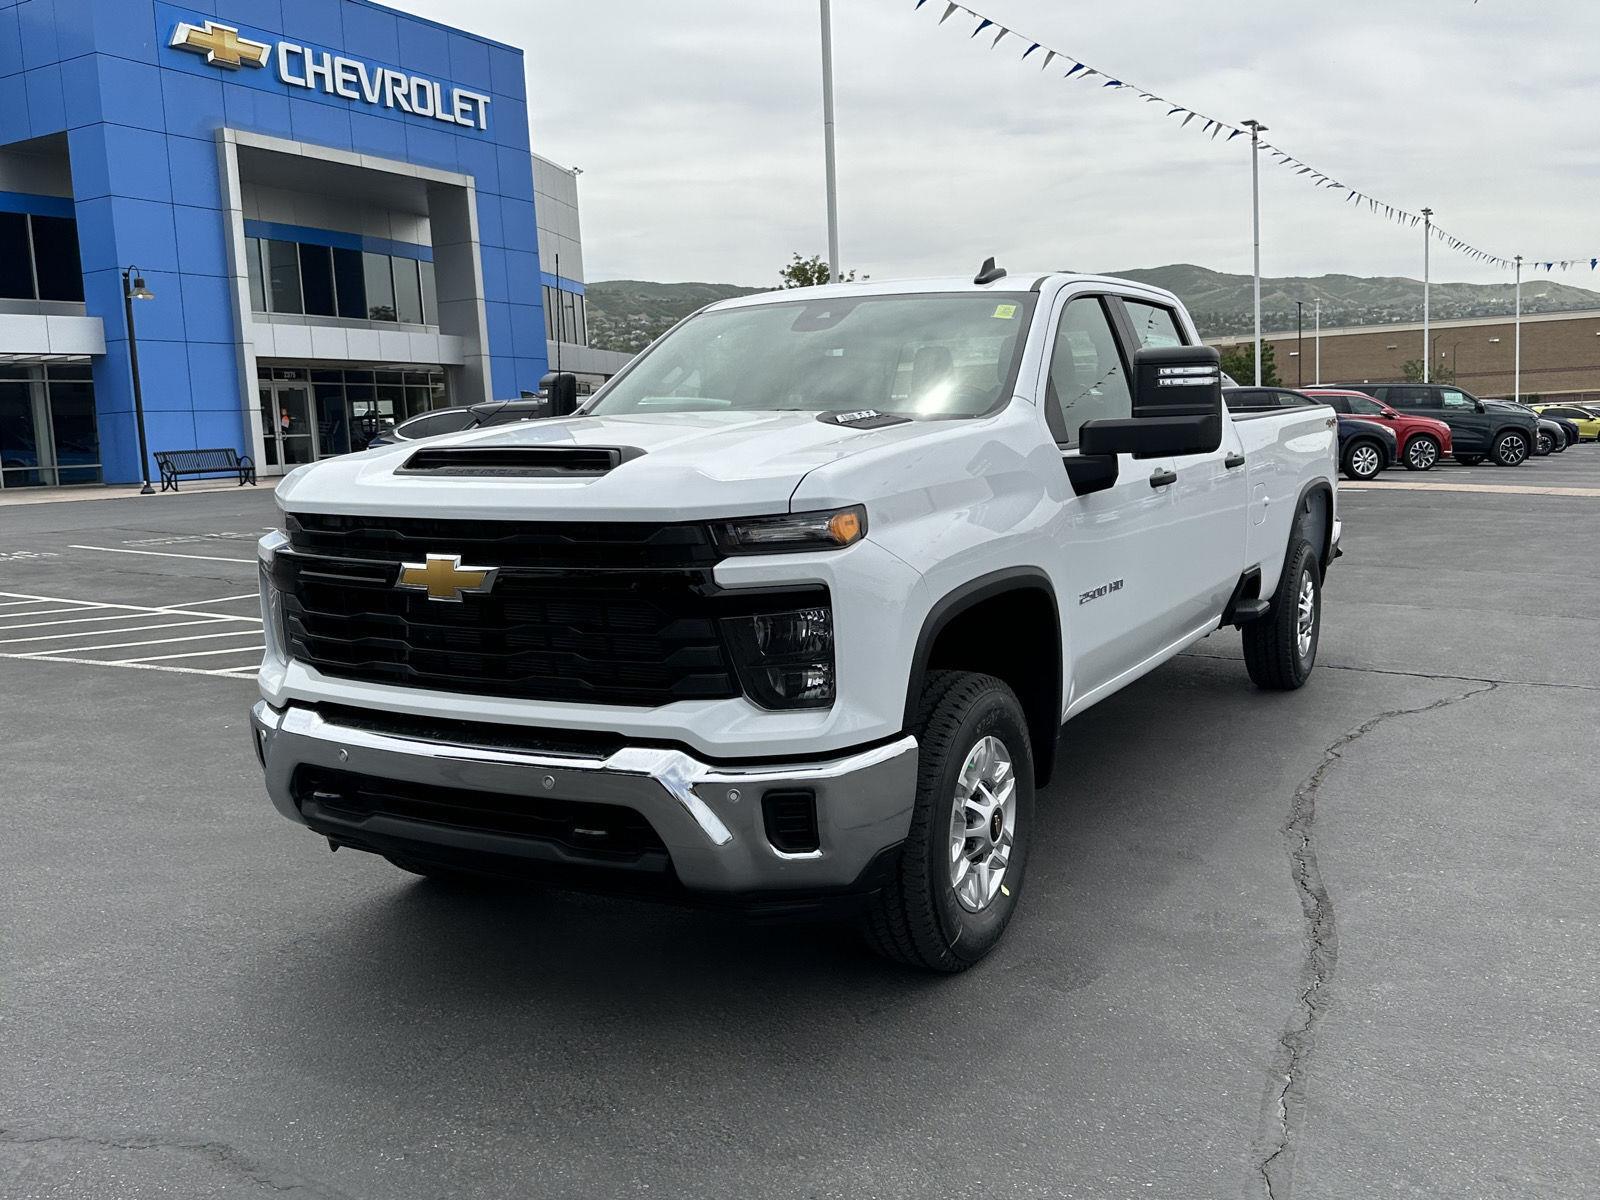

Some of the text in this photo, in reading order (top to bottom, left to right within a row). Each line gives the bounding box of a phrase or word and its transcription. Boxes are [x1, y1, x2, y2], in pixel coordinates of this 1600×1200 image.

[278, 41, 491, 130] CHEVROLET
[1079, 579, 1123, 605] 2500 HD
